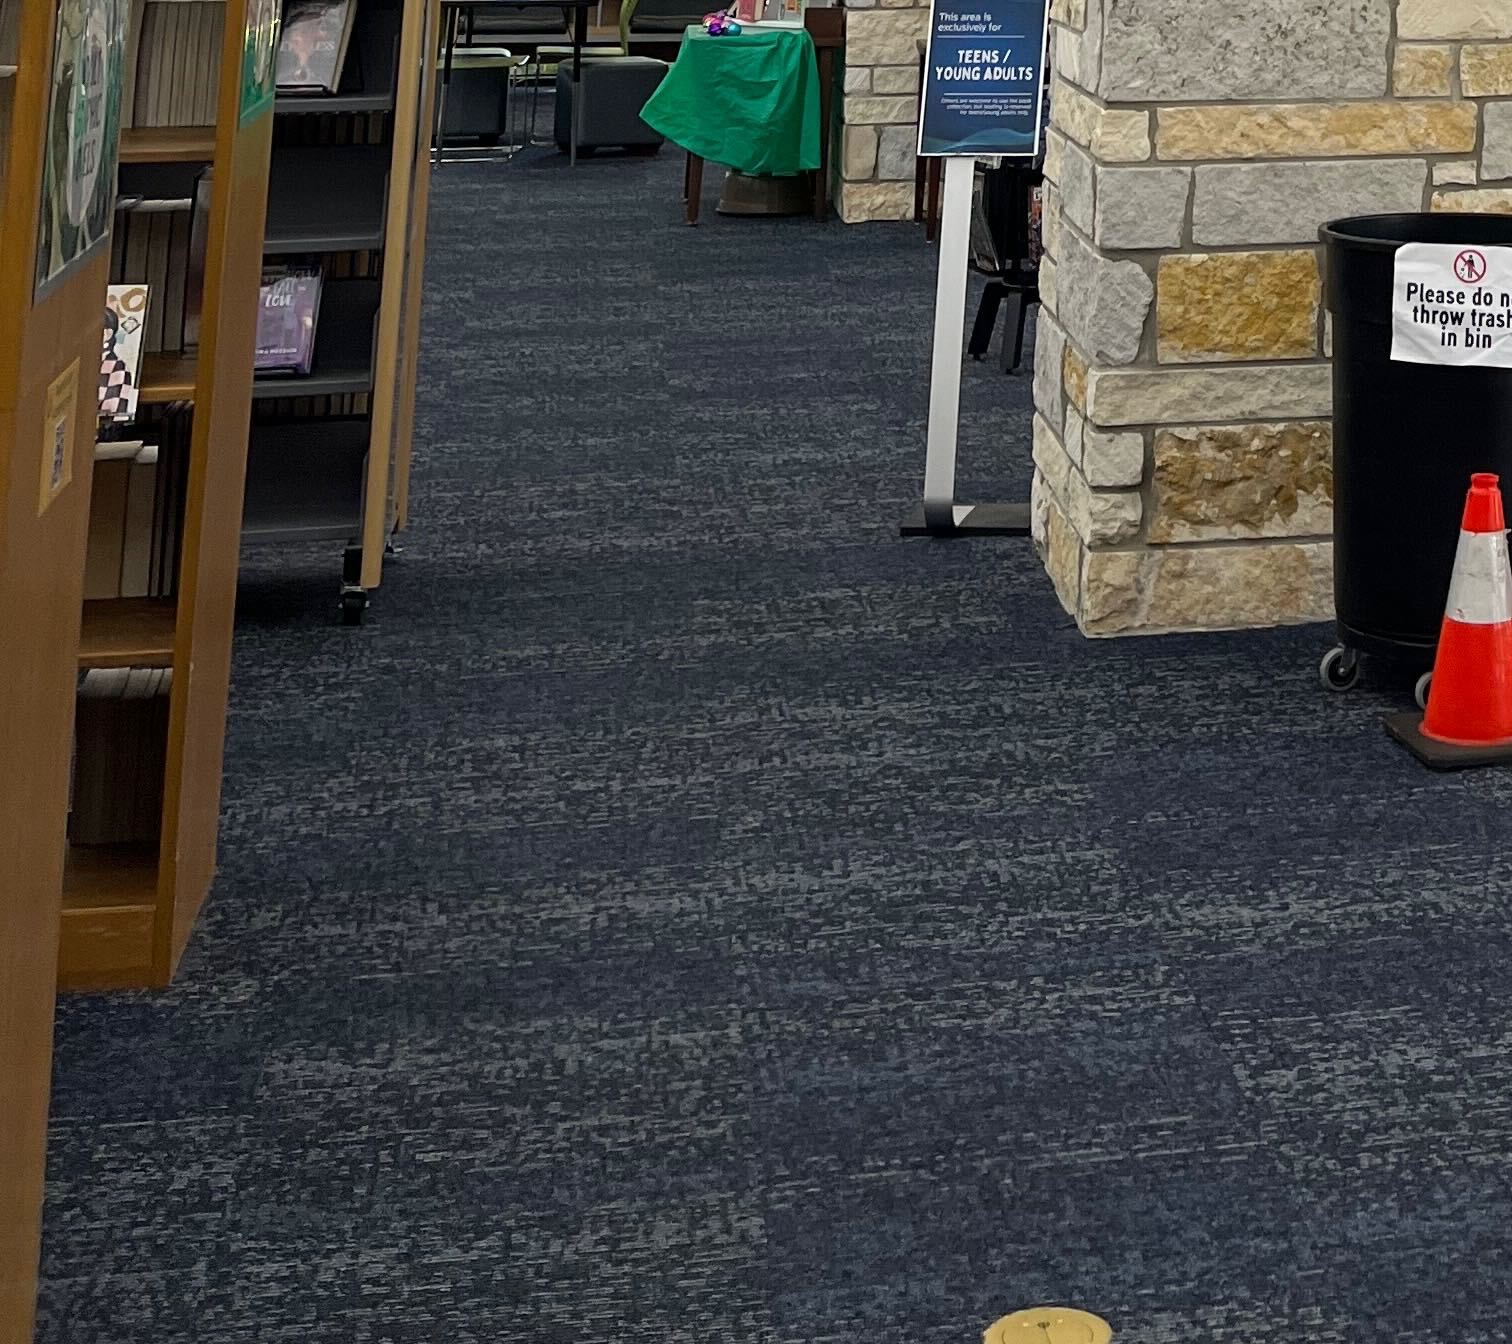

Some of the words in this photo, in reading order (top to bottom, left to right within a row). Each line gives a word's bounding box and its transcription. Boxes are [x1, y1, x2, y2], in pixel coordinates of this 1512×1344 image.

[939, 12, 959, 22] This
[960, 14, 981, 22] area
[983, 12, 992, 22] is
[937, 22, 987, 33] exclusively
[988, 22, 1002, 32] for
[957, 49, 999, 64] TEENS
[935, 66, 981, 81] YOUNG
[983, 66, 1033, 81] ADULTS
[1406, 282, 1466, 305] Please
[1472, 286, 1493, 306] do
[1412, 304, 1465, 326] throw
[1440, 325, 1457, 347] in
[1464, 327, 1492, 349] bin
